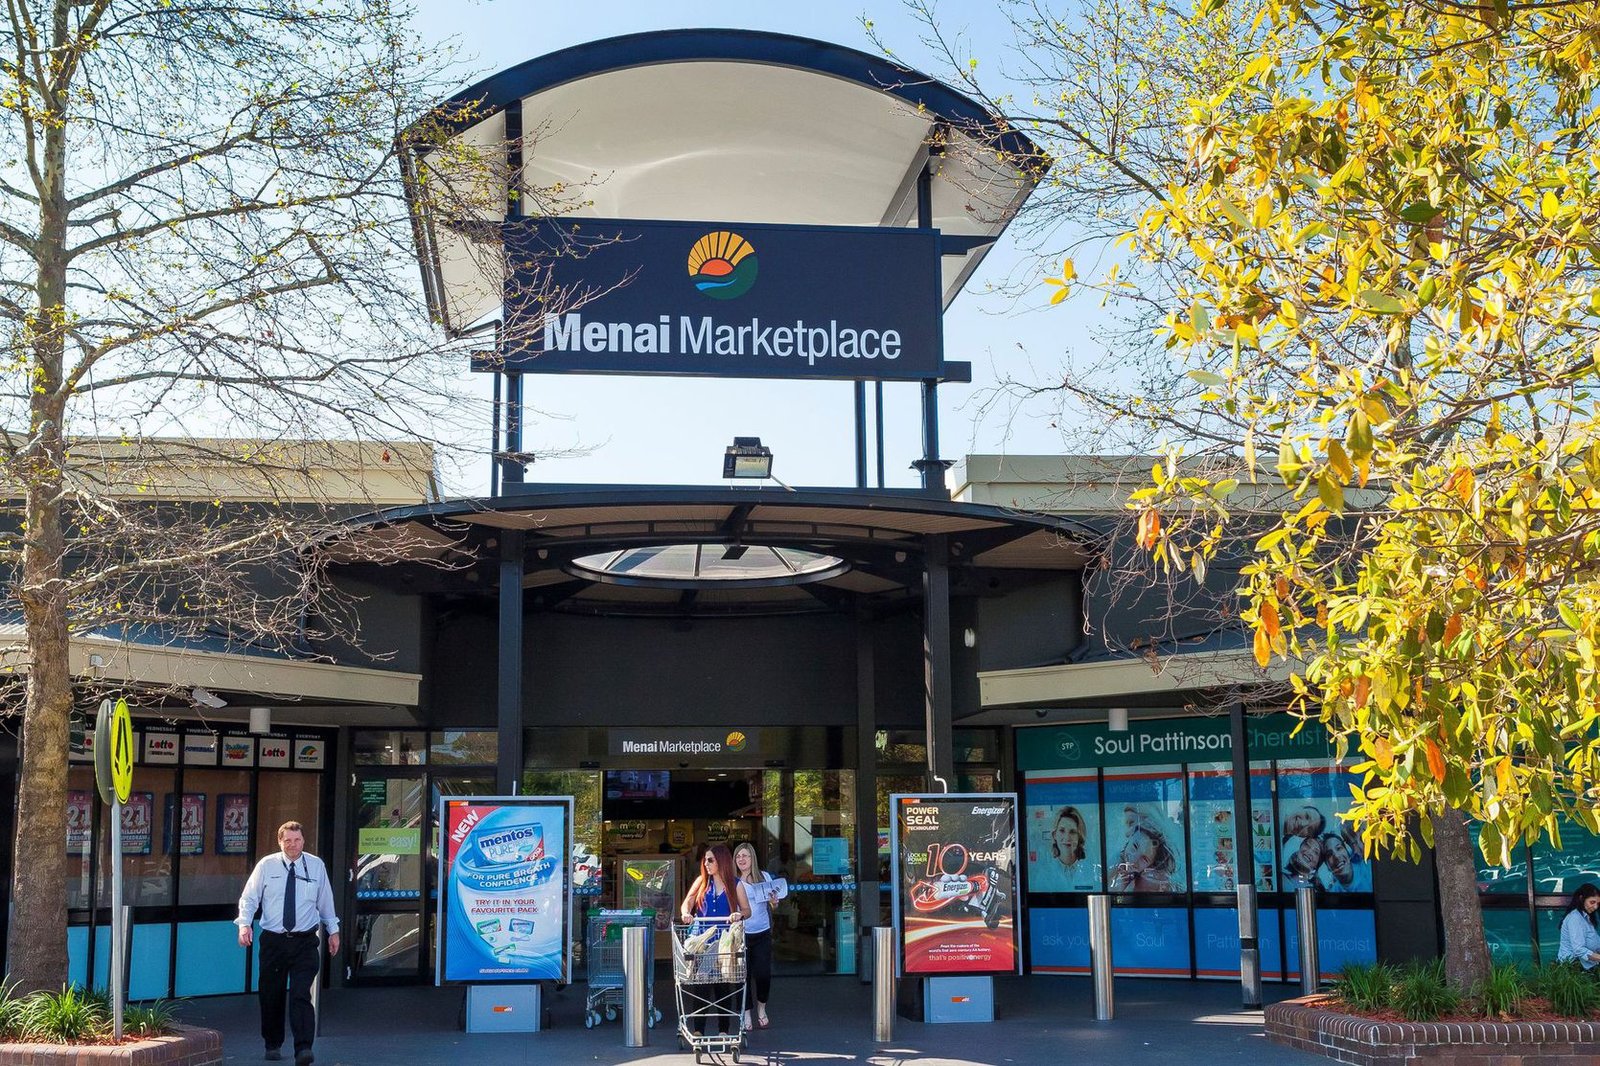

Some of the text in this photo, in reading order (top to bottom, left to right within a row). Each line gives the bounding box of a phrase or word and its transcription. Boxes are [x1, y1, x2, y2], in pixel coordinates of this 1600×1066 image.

[544, 313, 902, 366] Menai Marketplace
[149, 739, 174, 749] Lotto
[622, 740, 721, 755] Menai Marketplace
[1061, 742, 1075, 751] STP
[1094, 734, 1135, 755] Soul
[1140, 731, 1232, 753] Pattinson
[262, 747, 286, 758] Lotto
[67, 805, 91, 827] 21
[122, 804, 146, 827] 21
[906, 806, 939, 815] POWER
[971, 806, 1006, 816] Energizer
[451, 809, 479, 843] NEW
[906, 815, 940, 825] SEAL
[480, 828, 534, 849] mentos
[488, 843, 515, 858] PURE
[968, 851, 1007, 862] YEARS
[926, 843, 968, 878] 10
[467, 873, 485, 881] FOR
[513, 862, 551, 878] BREATH
[480, 874, 538, 888] CONFIDENCE
[943, 883, 968, 893] Energizer
[1042, 933, 1064, 947] ask
[1067, 935, 1090, 949] you
[1136, 933, 1165, 947] Soul
